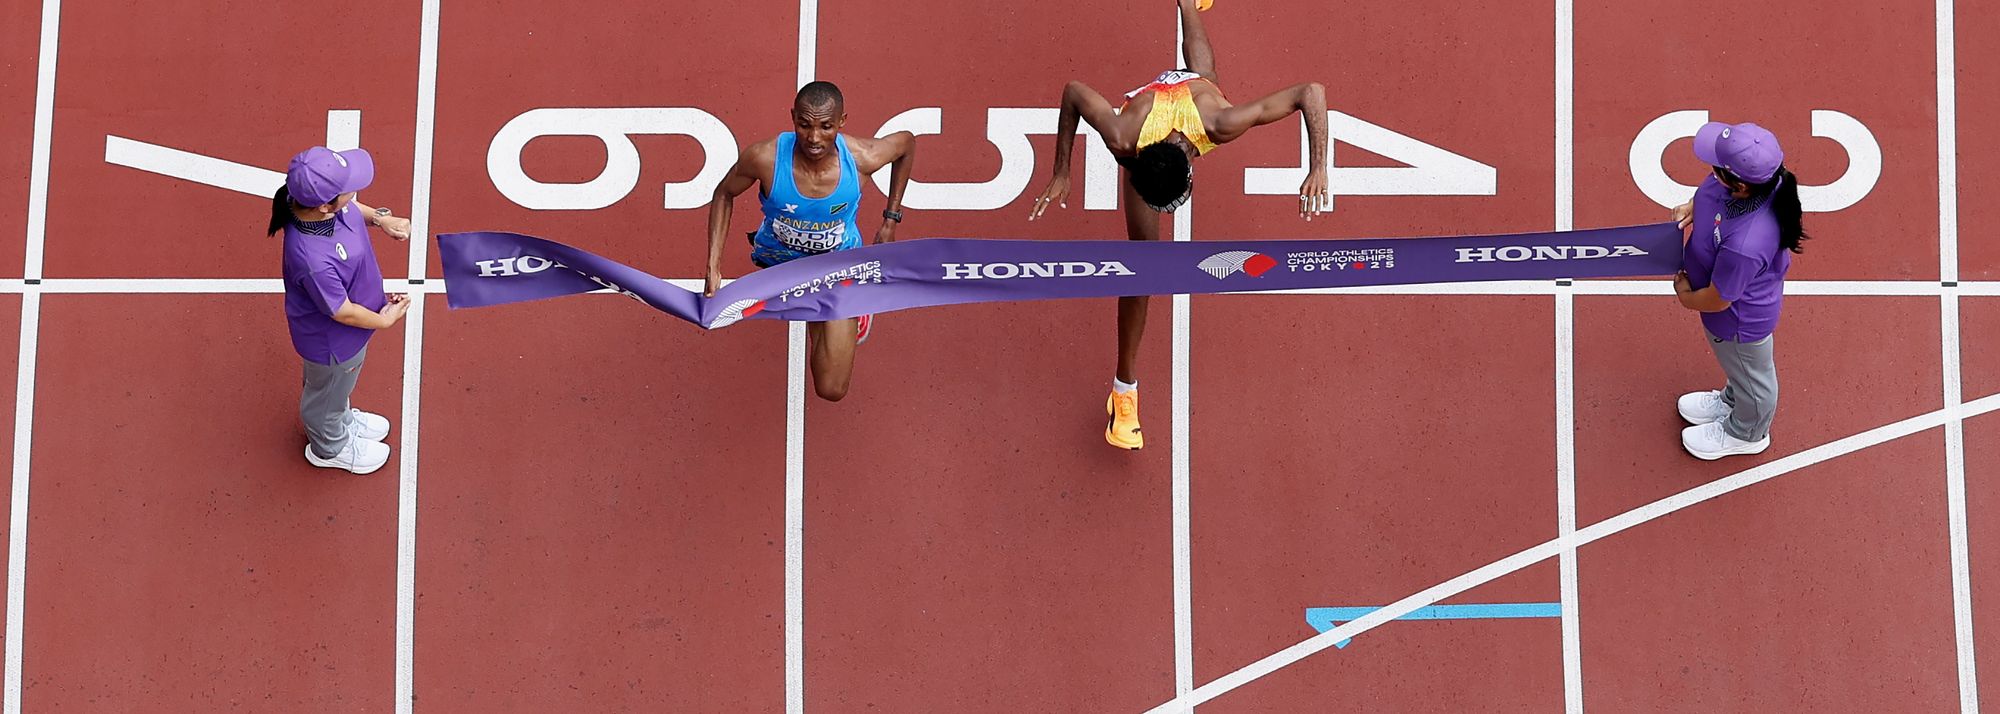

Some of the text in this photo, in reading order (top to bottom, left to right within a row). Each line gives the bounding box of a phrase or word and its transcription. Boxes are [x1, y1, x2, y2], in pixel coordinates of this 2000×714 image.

[487, 107, 739, 210] 6
[872, 107, 1118, 210] 5
[1244, 110, 1496, 212] 4
[1629, 110, 1882, 212] 3
[792, 227, 839, 241] TDK
[1287, 254, 1394, 265] CHAMPIONSHIPS
[1331, 248, 1394, 256] ATHLETICS
[1454, 245, 1649, 263] HONDA
[823, 260, 881, 283] ATHLETICS
[941, 261, 1136, 280] HONDA
